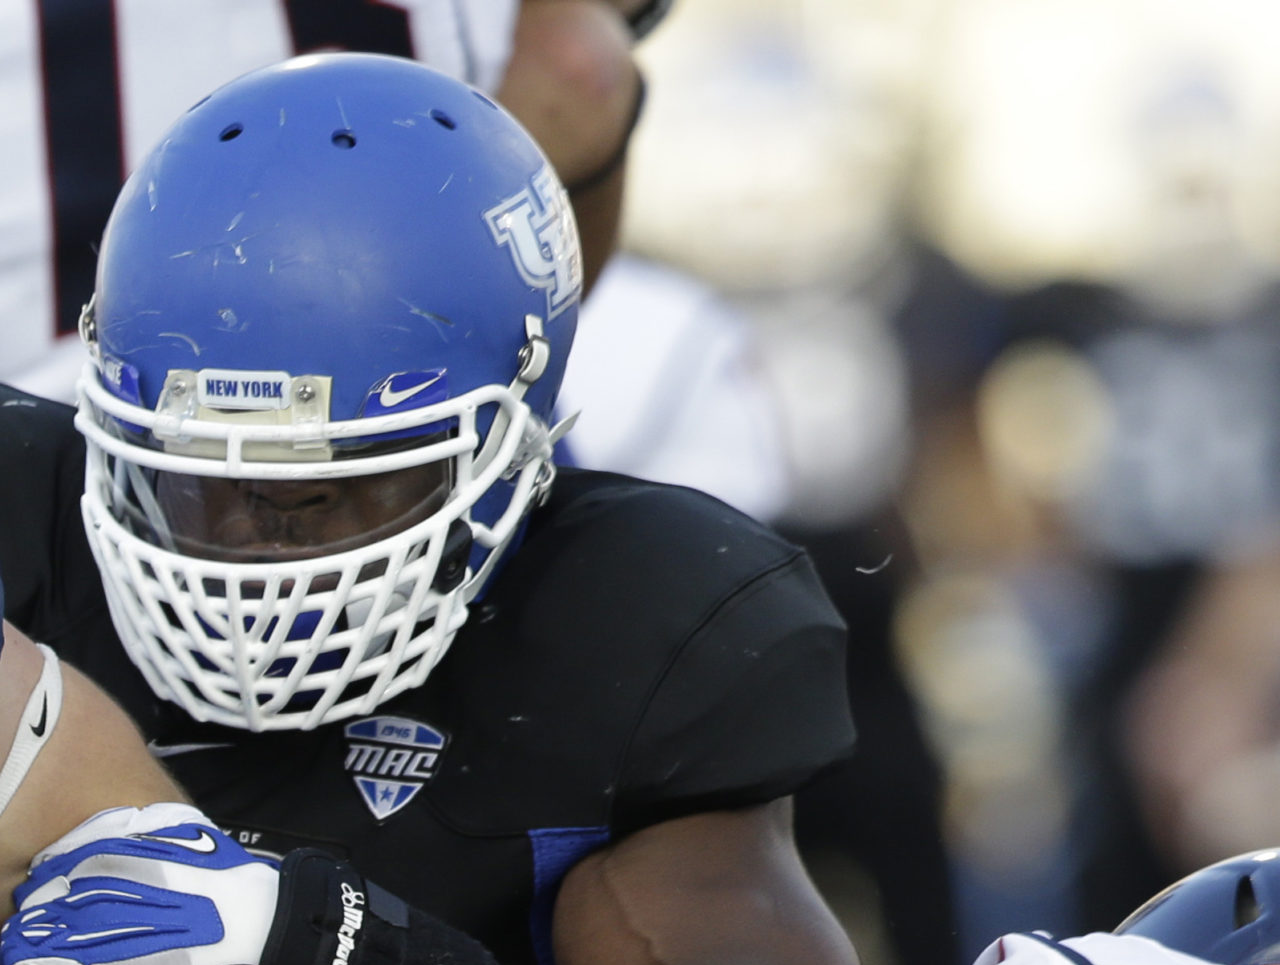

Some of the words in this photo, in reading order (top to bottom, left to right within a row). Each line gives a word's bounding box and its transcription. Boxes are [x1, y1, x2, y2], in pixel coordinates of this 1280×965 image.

[205, 378, 239, 398] NEW
[241, 379, 284, 400] YORK
[344, 743, 439, 779] MAC
[239, 831, 262, 845] OF
